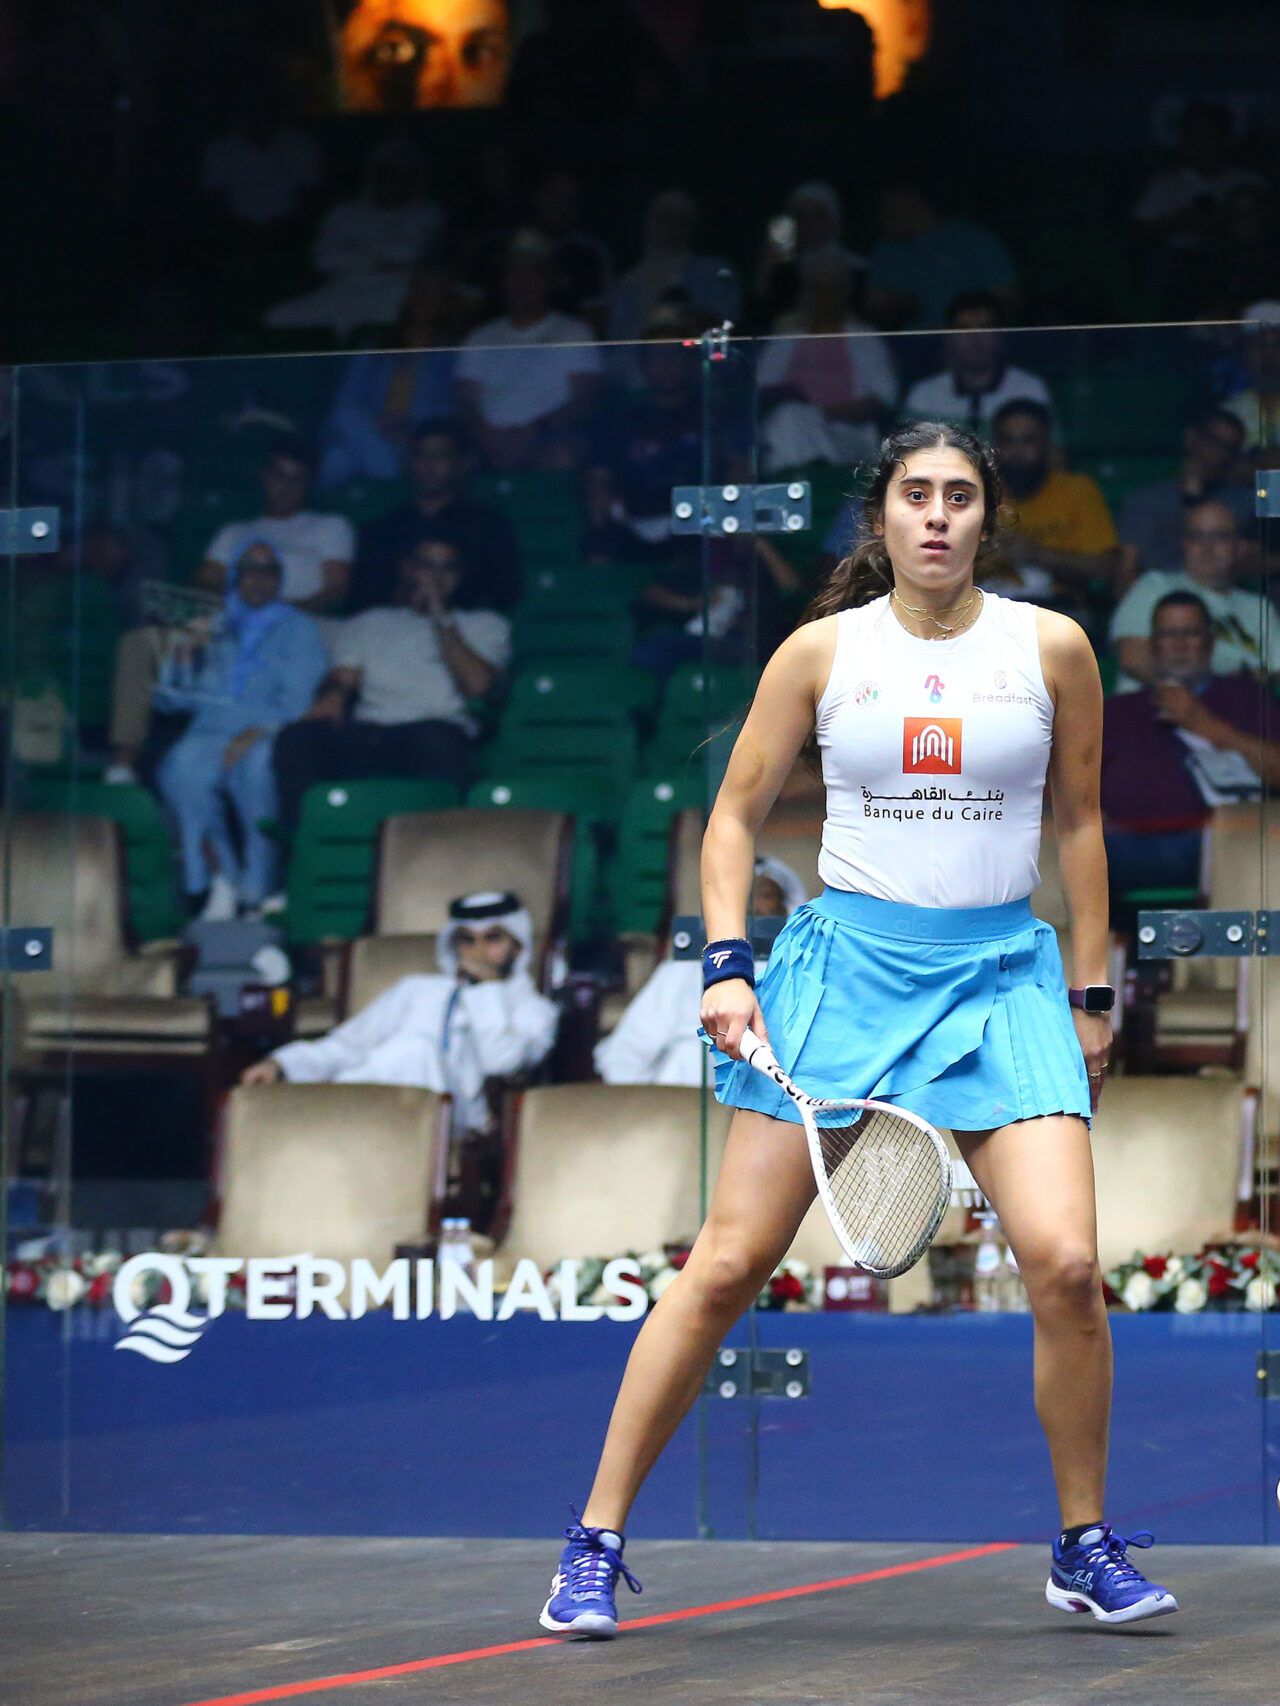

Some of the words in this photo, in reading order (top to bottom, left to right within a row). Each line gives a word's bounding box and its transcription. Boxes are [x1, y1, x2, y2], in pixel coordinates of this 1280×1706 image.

[860, 785, 947, 803] القاهرة
[863, 803, 925, 821] Banque
[932, 805, 954, 821] du
[961, 805, 1003, 821] Caire
[113, 1251, 648, 1364] QTERMINALS
